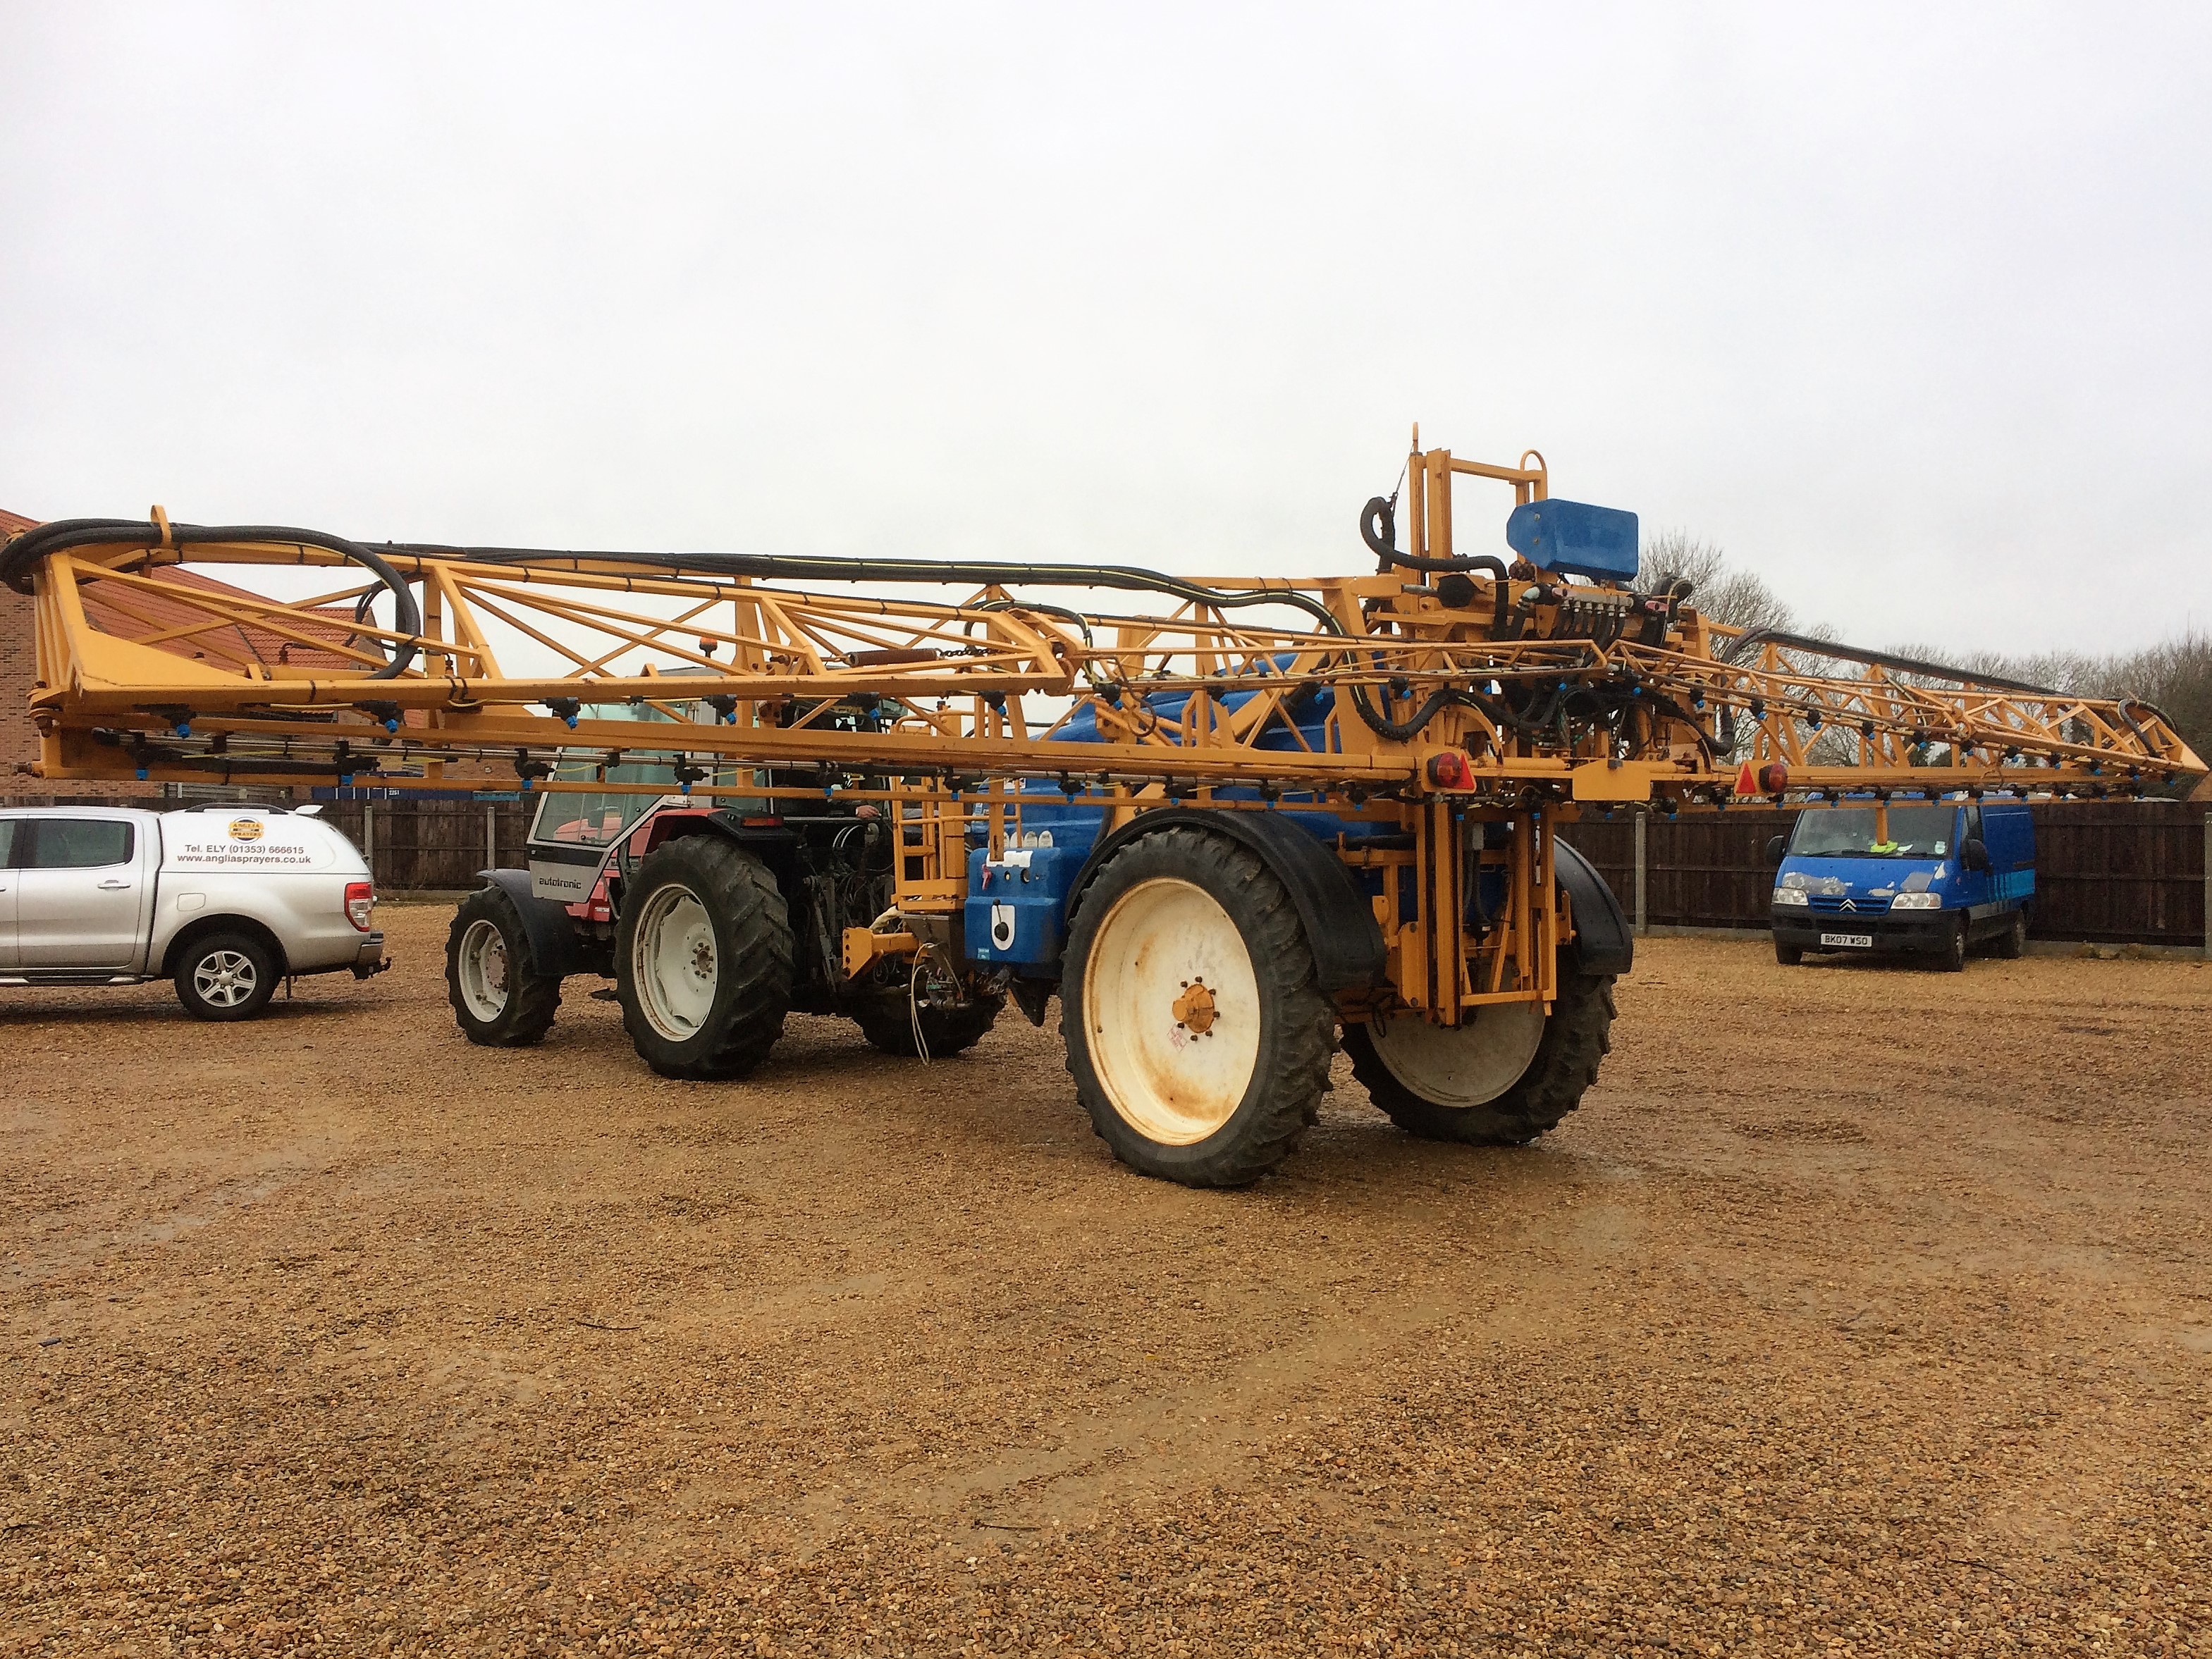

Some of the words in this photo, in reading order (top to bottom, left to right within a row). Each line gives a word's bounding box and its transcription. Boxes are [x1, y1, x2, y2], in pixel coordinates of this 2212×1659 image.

[185, 844, 203, 853] Tel.
[229, 844, 266, 854] (01353)
[269, 846, 305, 854] 666615
[177, 854, 312, 865] www.angliasprayers.co.uk
[539, 876, 582, 889] autotronic
[1824, 935, 1848, 944] BK07
